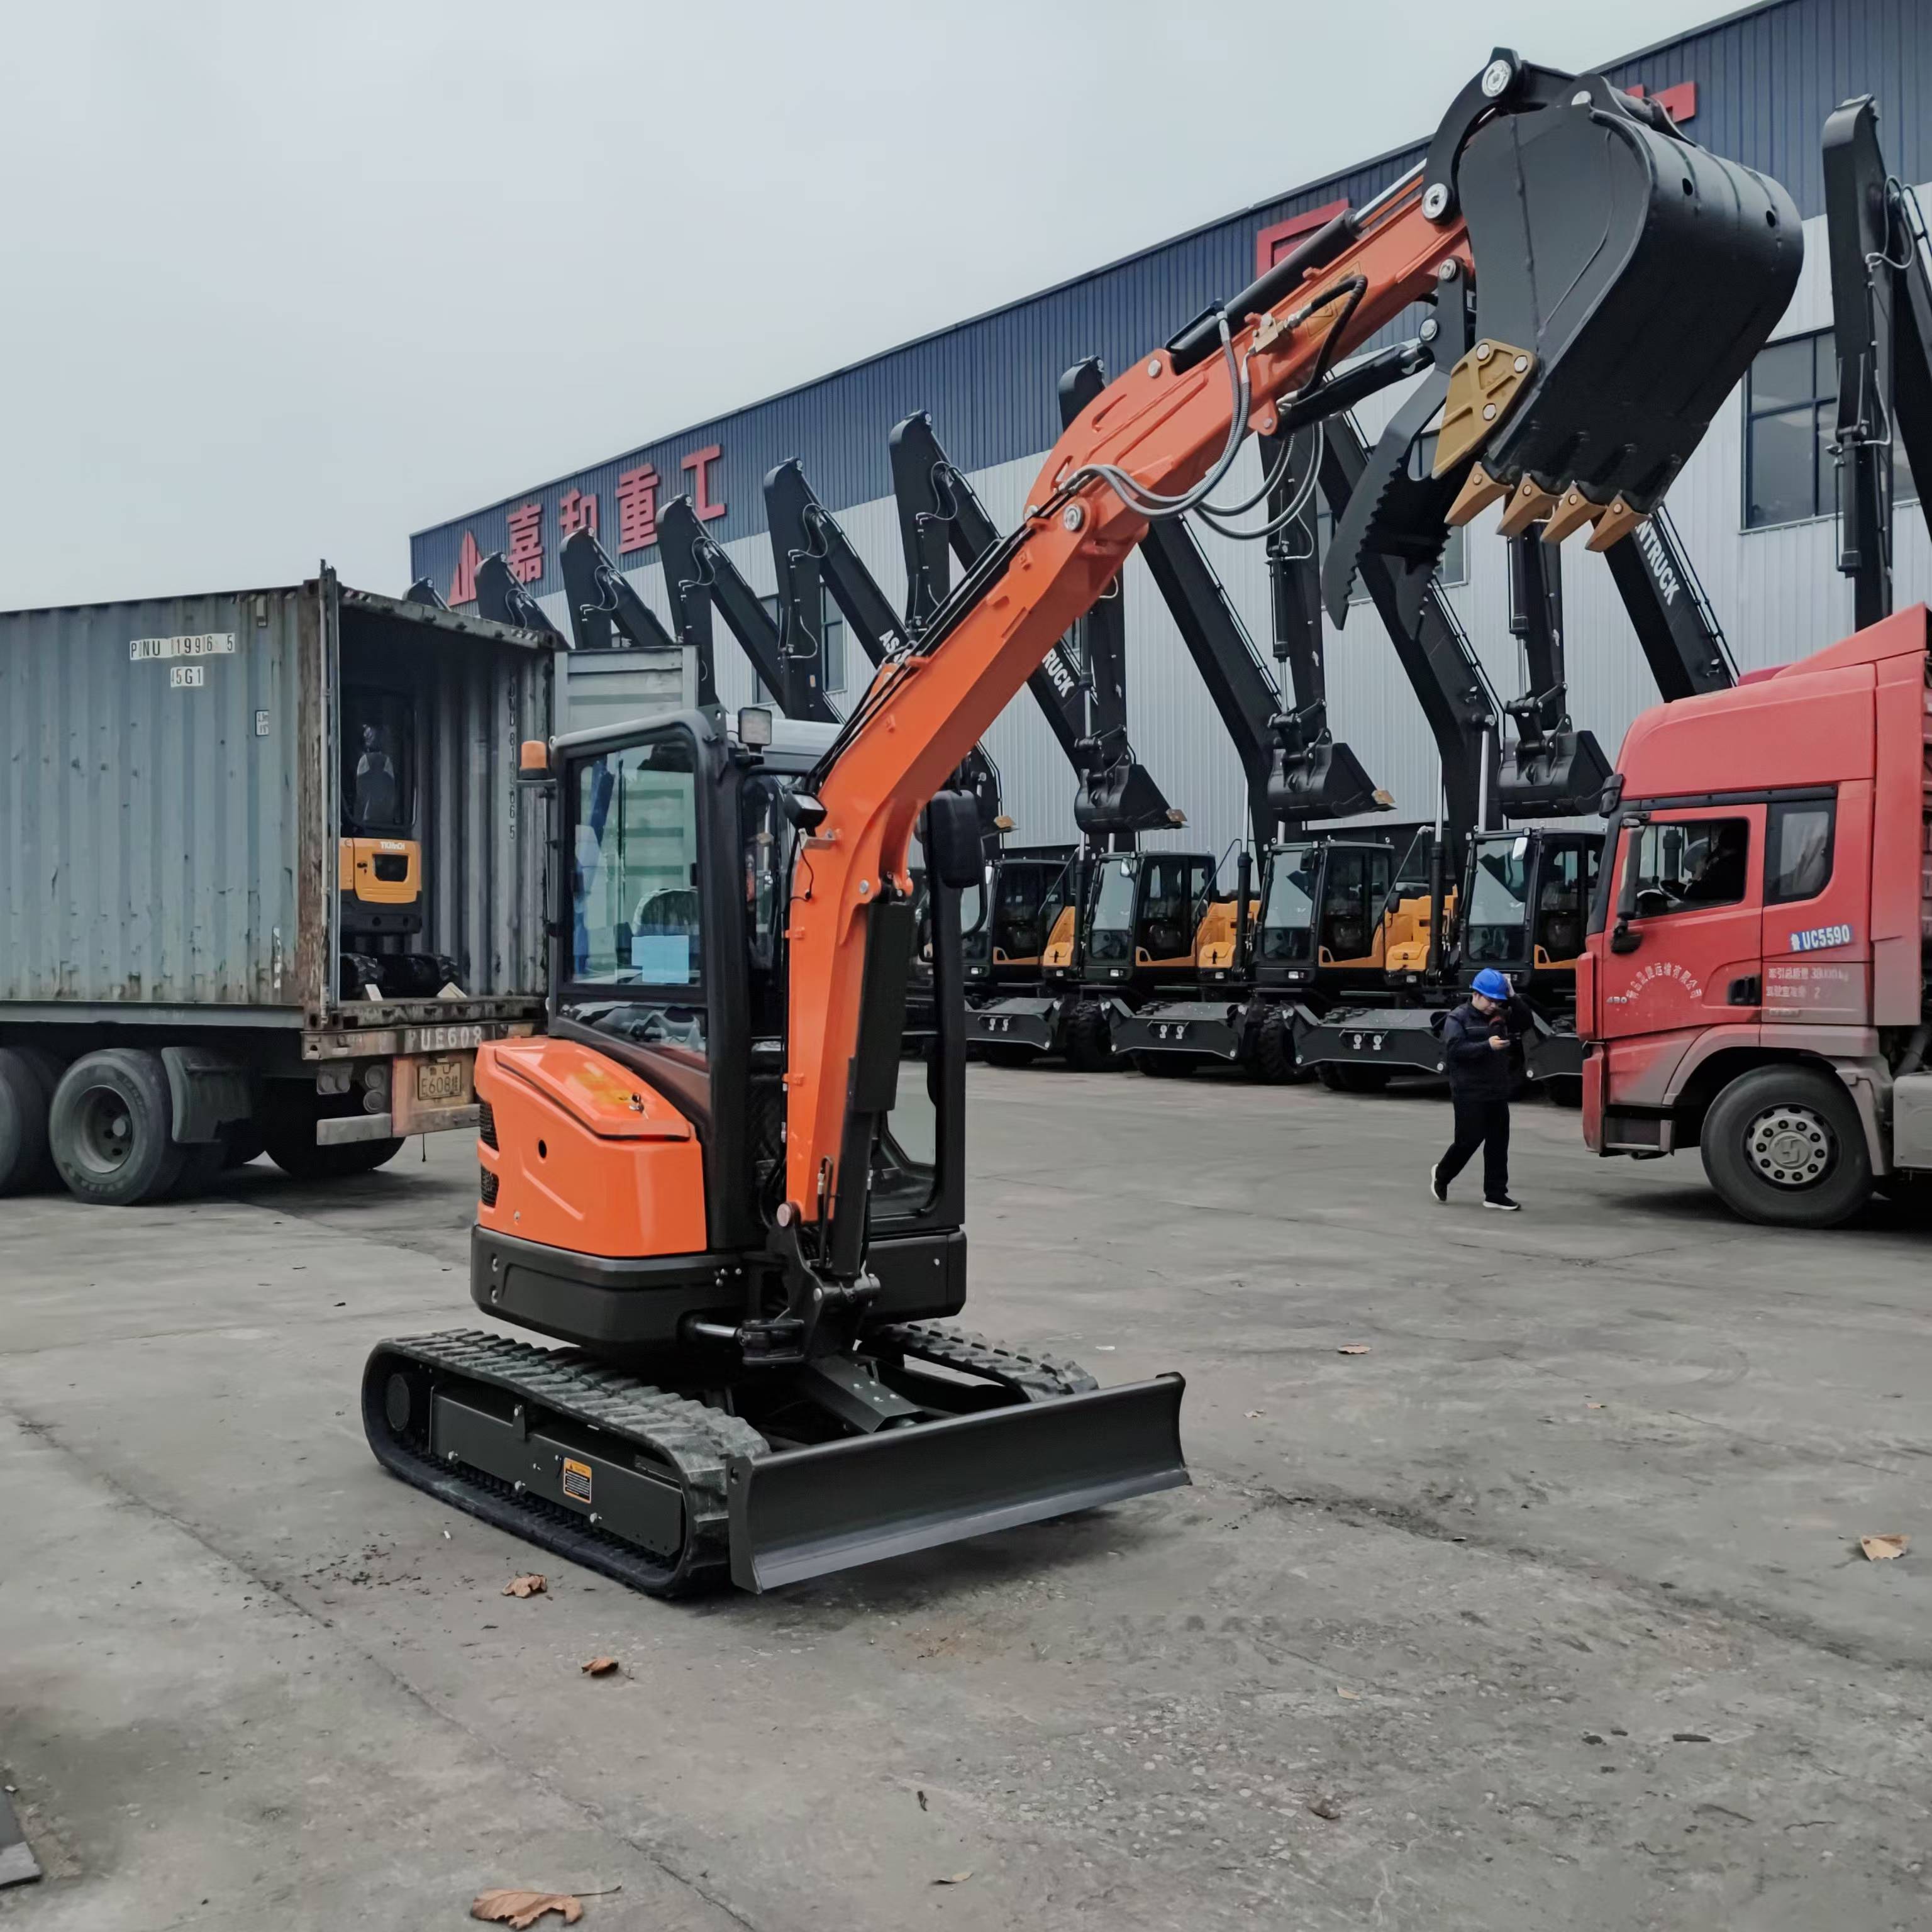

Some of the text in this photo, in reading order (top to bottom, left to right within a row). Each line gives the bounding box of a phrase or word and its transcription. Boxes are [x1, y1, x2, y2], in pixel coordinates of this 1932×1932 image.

[507, 444, 726, 584] 嘉和重工
[1635, 519, 1680, 606] NTRUCK
[1041, 648, 1075, 697] RUCK
[409, 1025, 483, 1052] UE608
